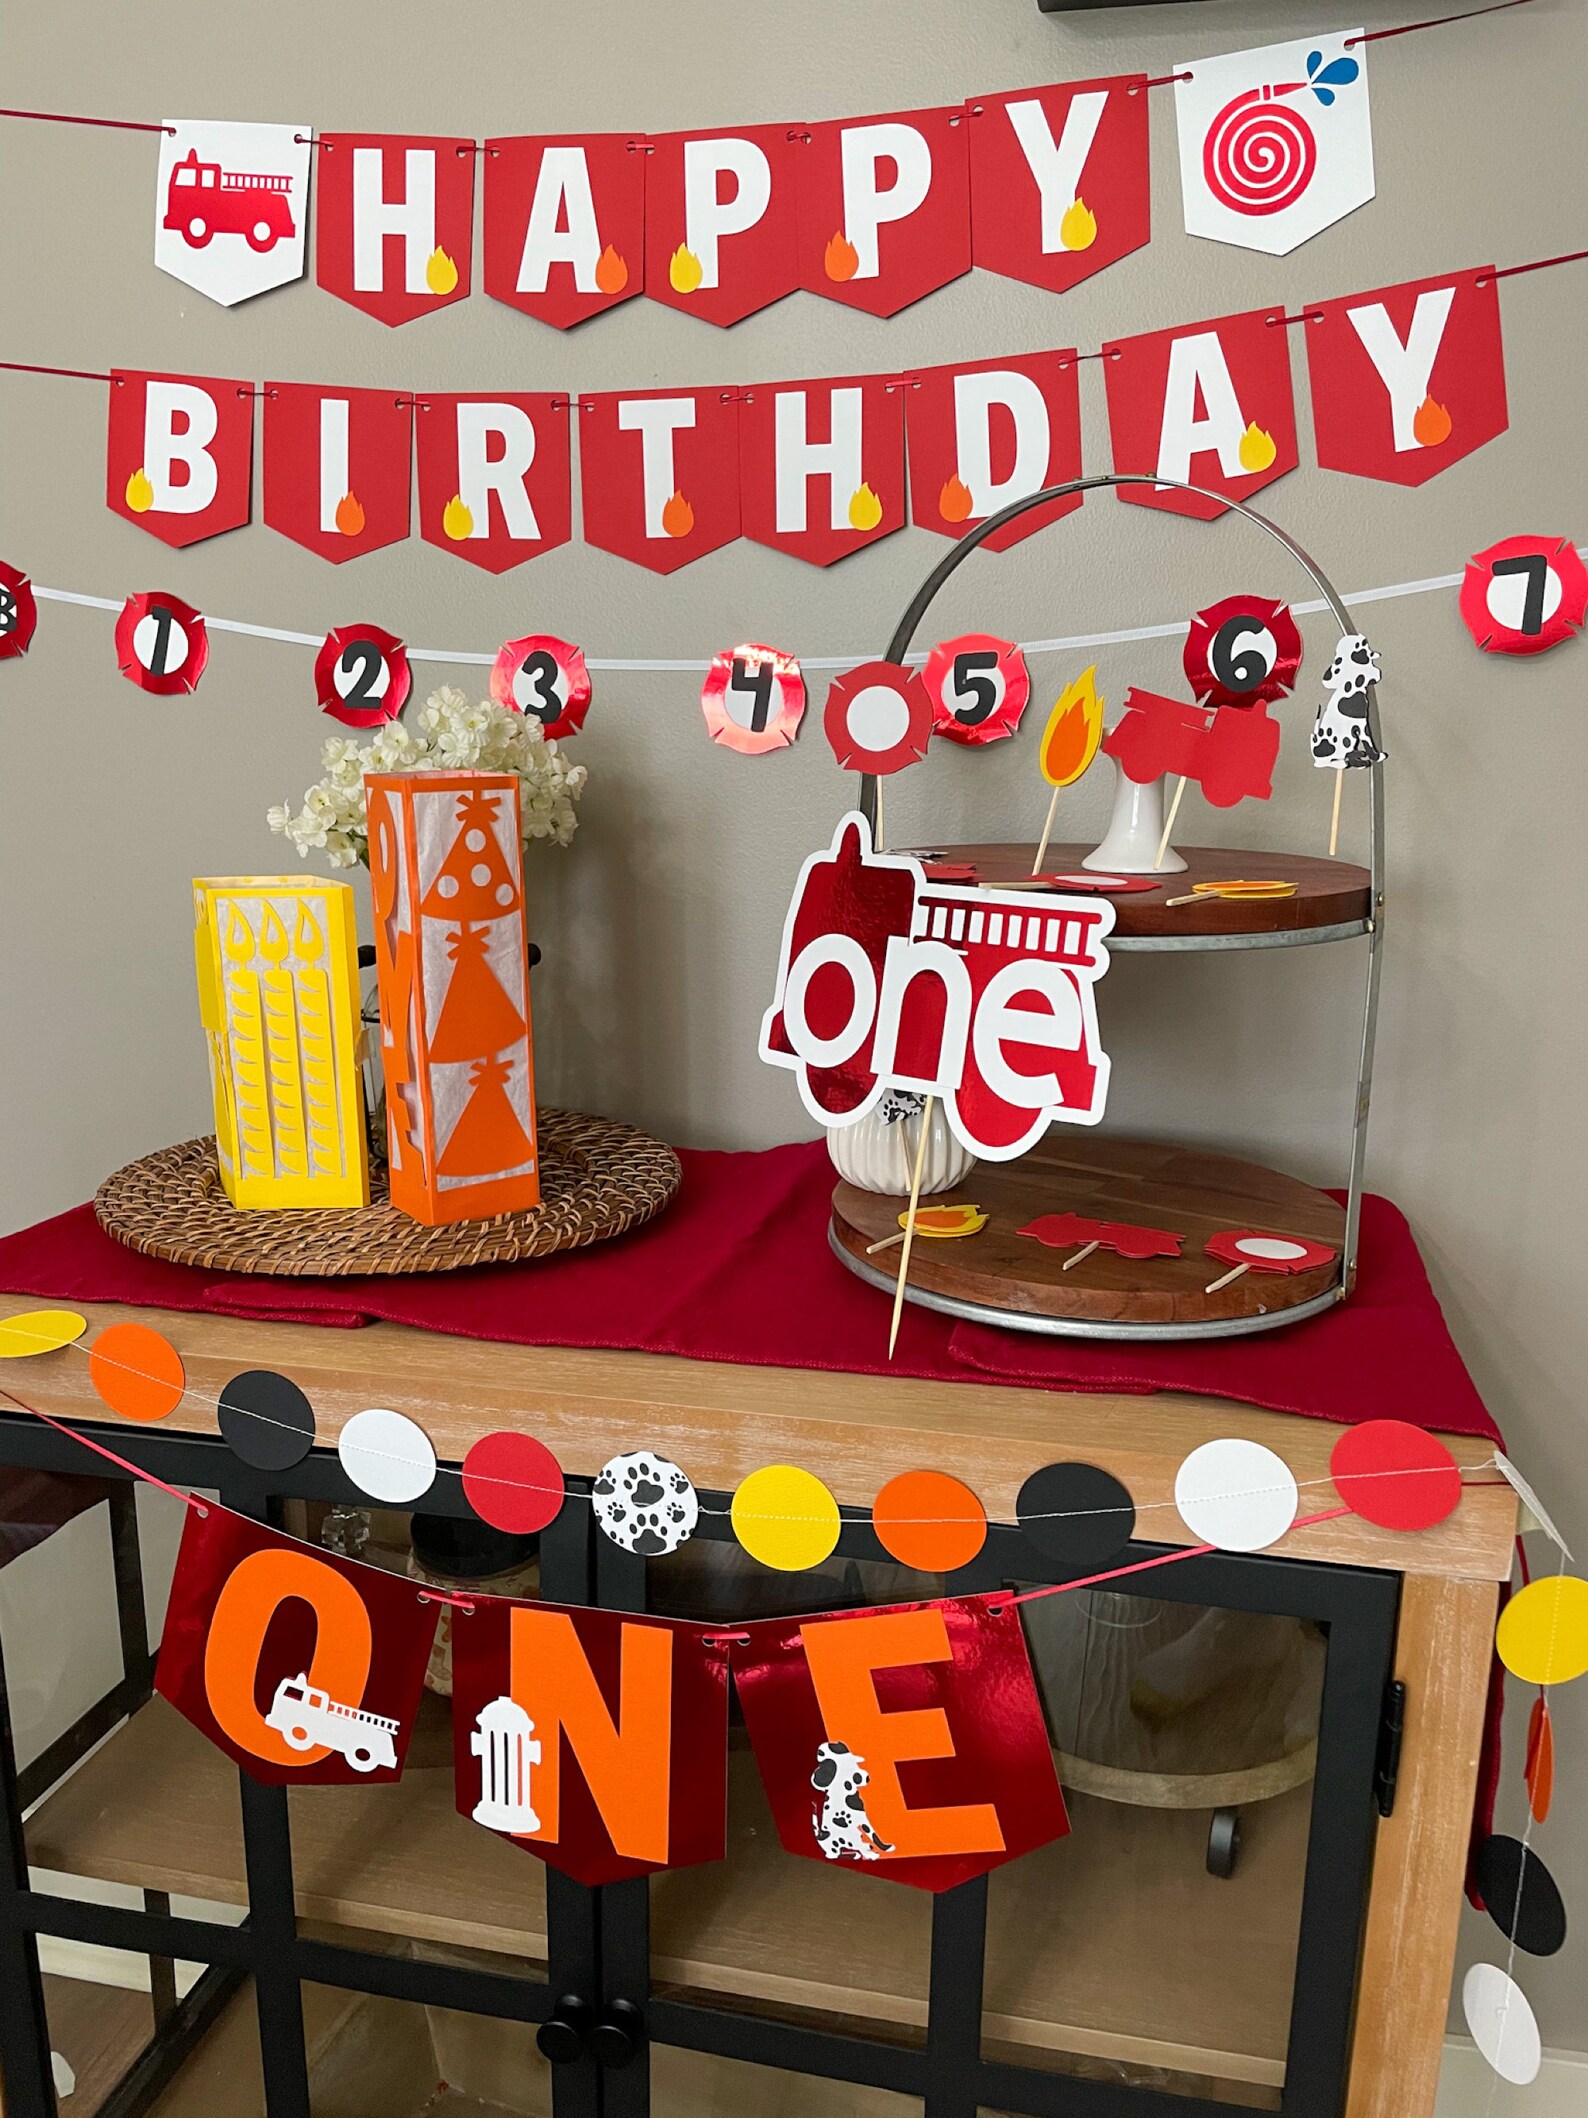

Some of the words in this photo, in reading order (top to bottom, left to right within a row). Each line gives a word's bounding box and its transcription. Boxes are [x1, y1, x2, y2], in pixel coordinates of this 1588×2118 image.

[352, 91, 1110, 293] HAPPY
[144, 286, 1457, 540] BIRTHDAY
[151, 606, 173, 676] 1
[341, 640, 383, 709] 2
[521, 651, 562, 723] 3
[730, 656, 774, 733] 4
[952, 652, 998, 726] 5
[1211, 614, 1268, 692] 6
[1491, 554, 1547, 636] 7
[782, 932, 1081, 1108] one
[204, 1549, 1007, 1866] ONE
